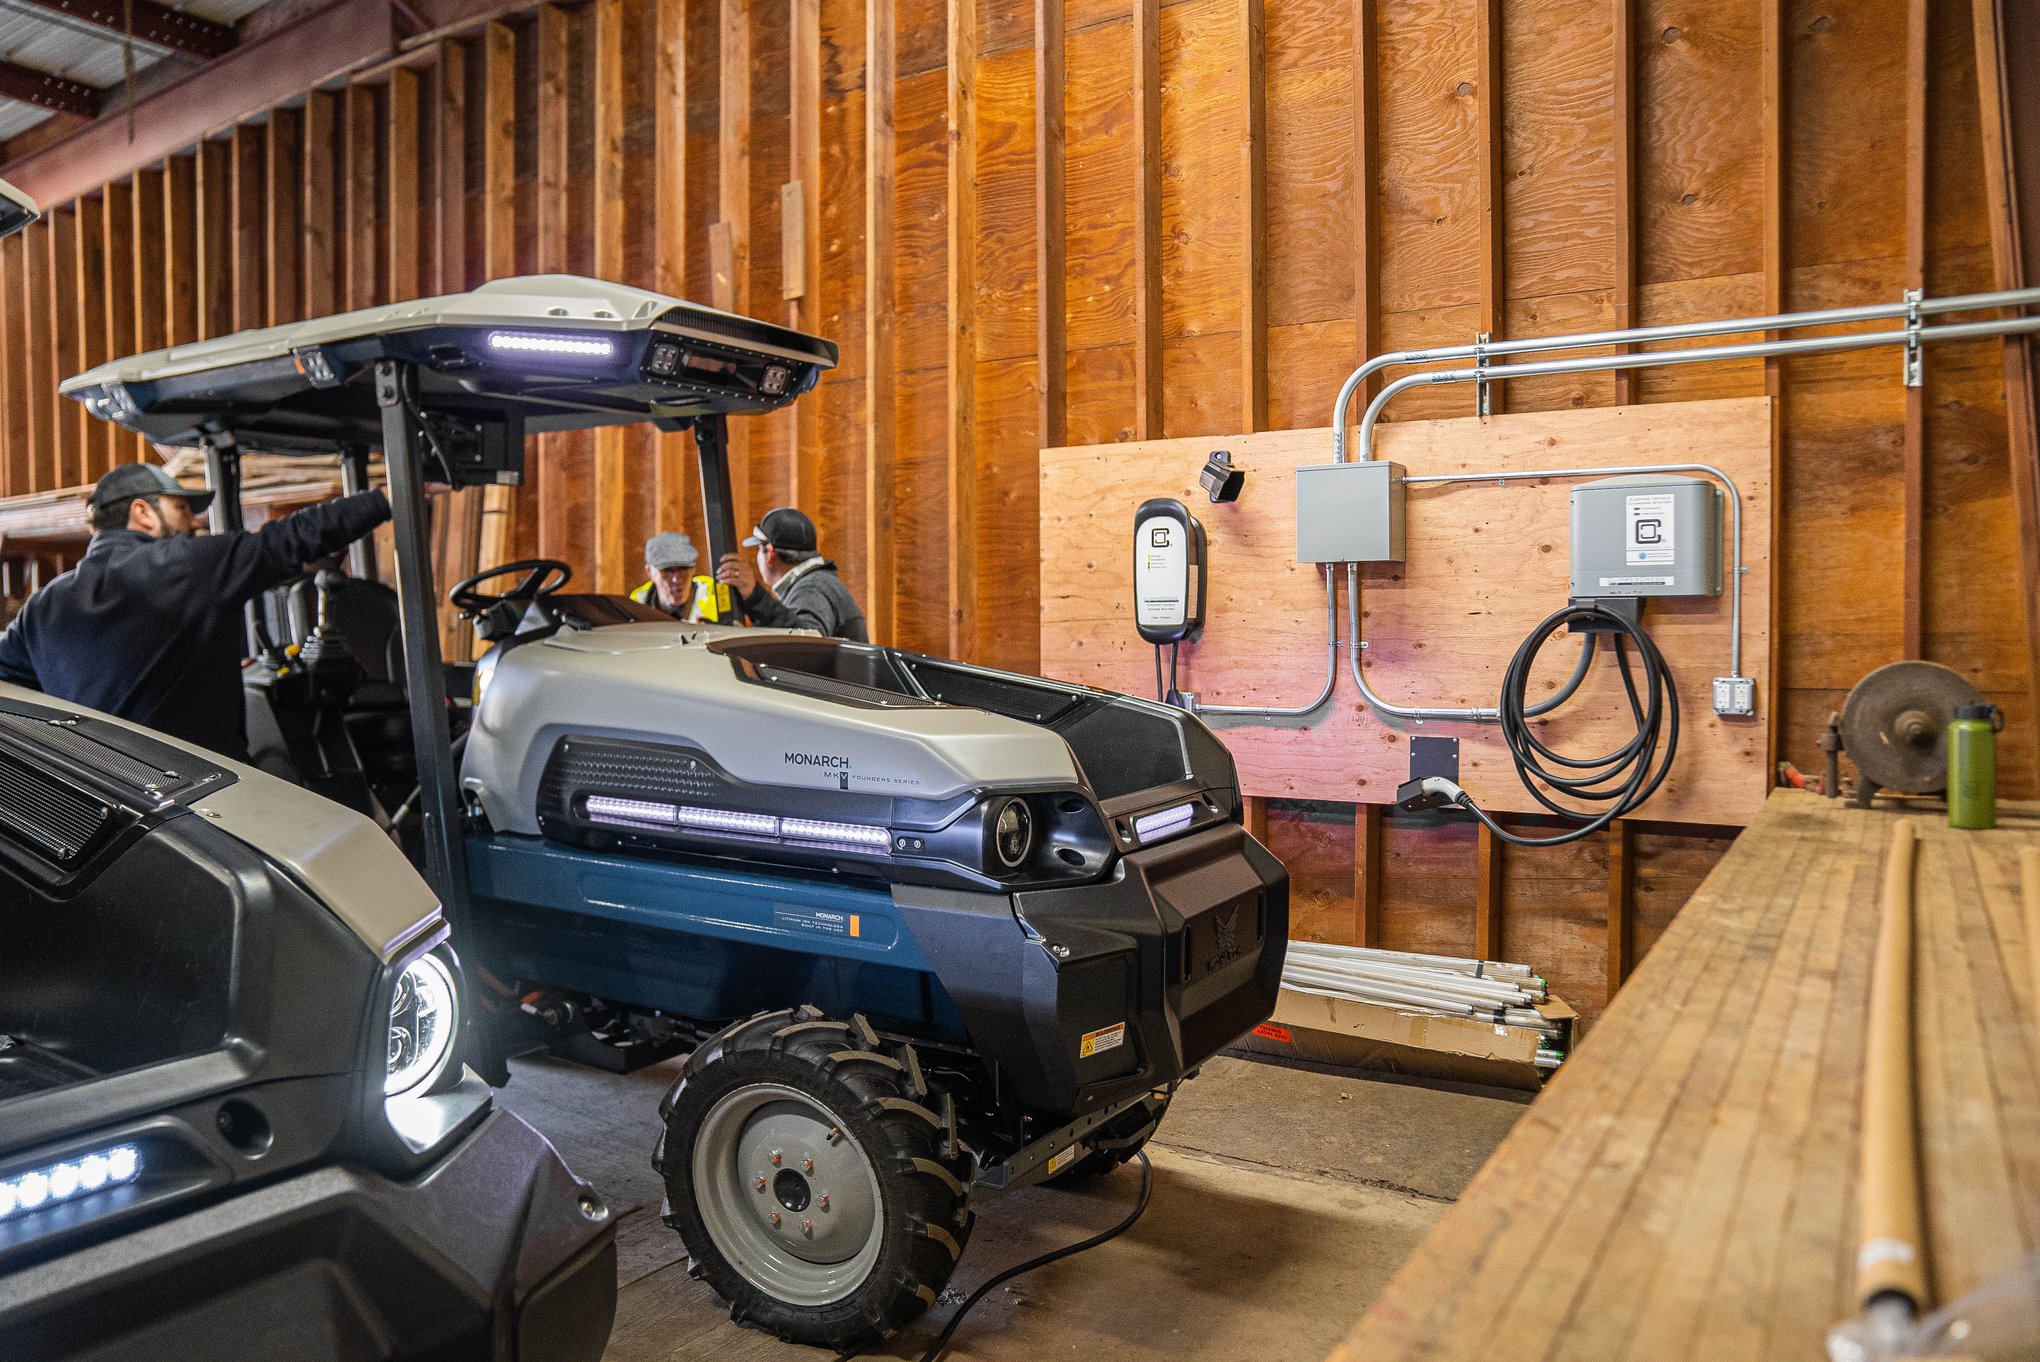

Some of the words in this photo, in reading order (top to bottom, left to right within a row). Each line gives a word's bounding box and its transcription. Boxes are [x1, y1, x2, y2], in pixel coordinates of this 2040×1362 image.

[784, 752, 849, 769] MONARCH
[852, 775, 891, 783] FOUNDERS
[893, 778, 920, 786] SERIES
[815, 912, 844, 921] MONARCH
